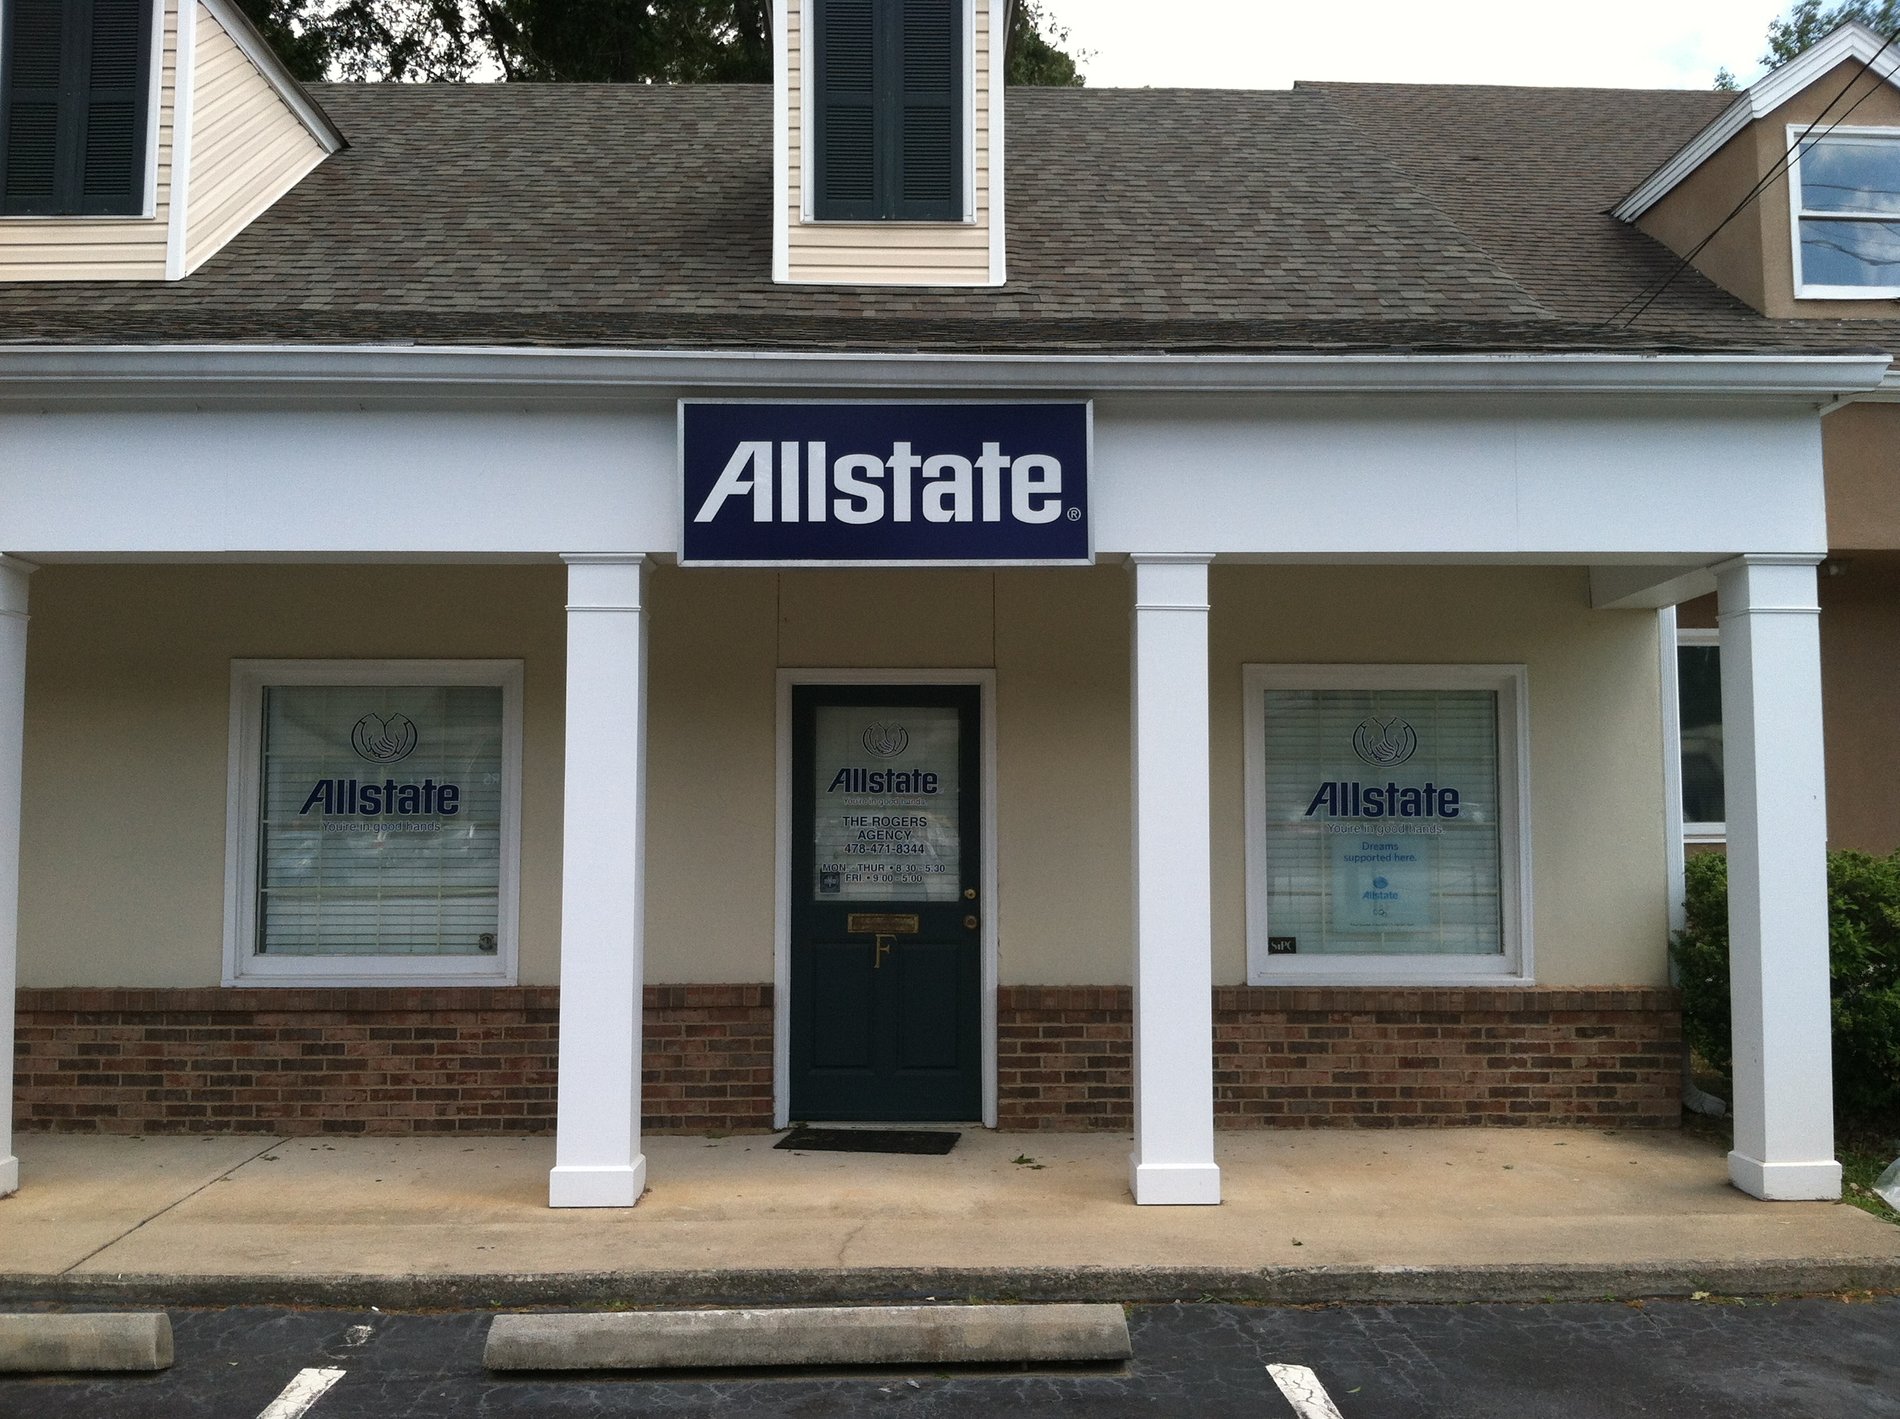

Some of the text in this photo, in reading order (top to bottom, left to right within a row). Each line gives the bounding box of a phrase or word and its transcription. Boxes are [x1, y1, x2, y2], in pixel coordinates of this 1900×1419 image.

[693, 441, 1063, 524] Allstate
[827, 768, 939, 794] Allstate
[299, 778, 461, 816] Allstate
[1303, 781, 1460, 818] Allstate
[360, 821, 371, 832] in
[374, 821, 402, 834] good
[843, 816, 928, 827] THE ROGERS
[857, 830, 912, 841] AGENCY
[1327, 823, 1361, 834] You're
[1364, 823, 1375, 834] in
[1377, 823, 1405, 836] good
[844, 843, 925, 854] 478-471-8344
[1361, 841, 1399, 851] Dreams
[1343, 853, 1417, 863] supported here.
[1362, 891, 1399, 900] Allstate
[874, 934, 897, 968] F
